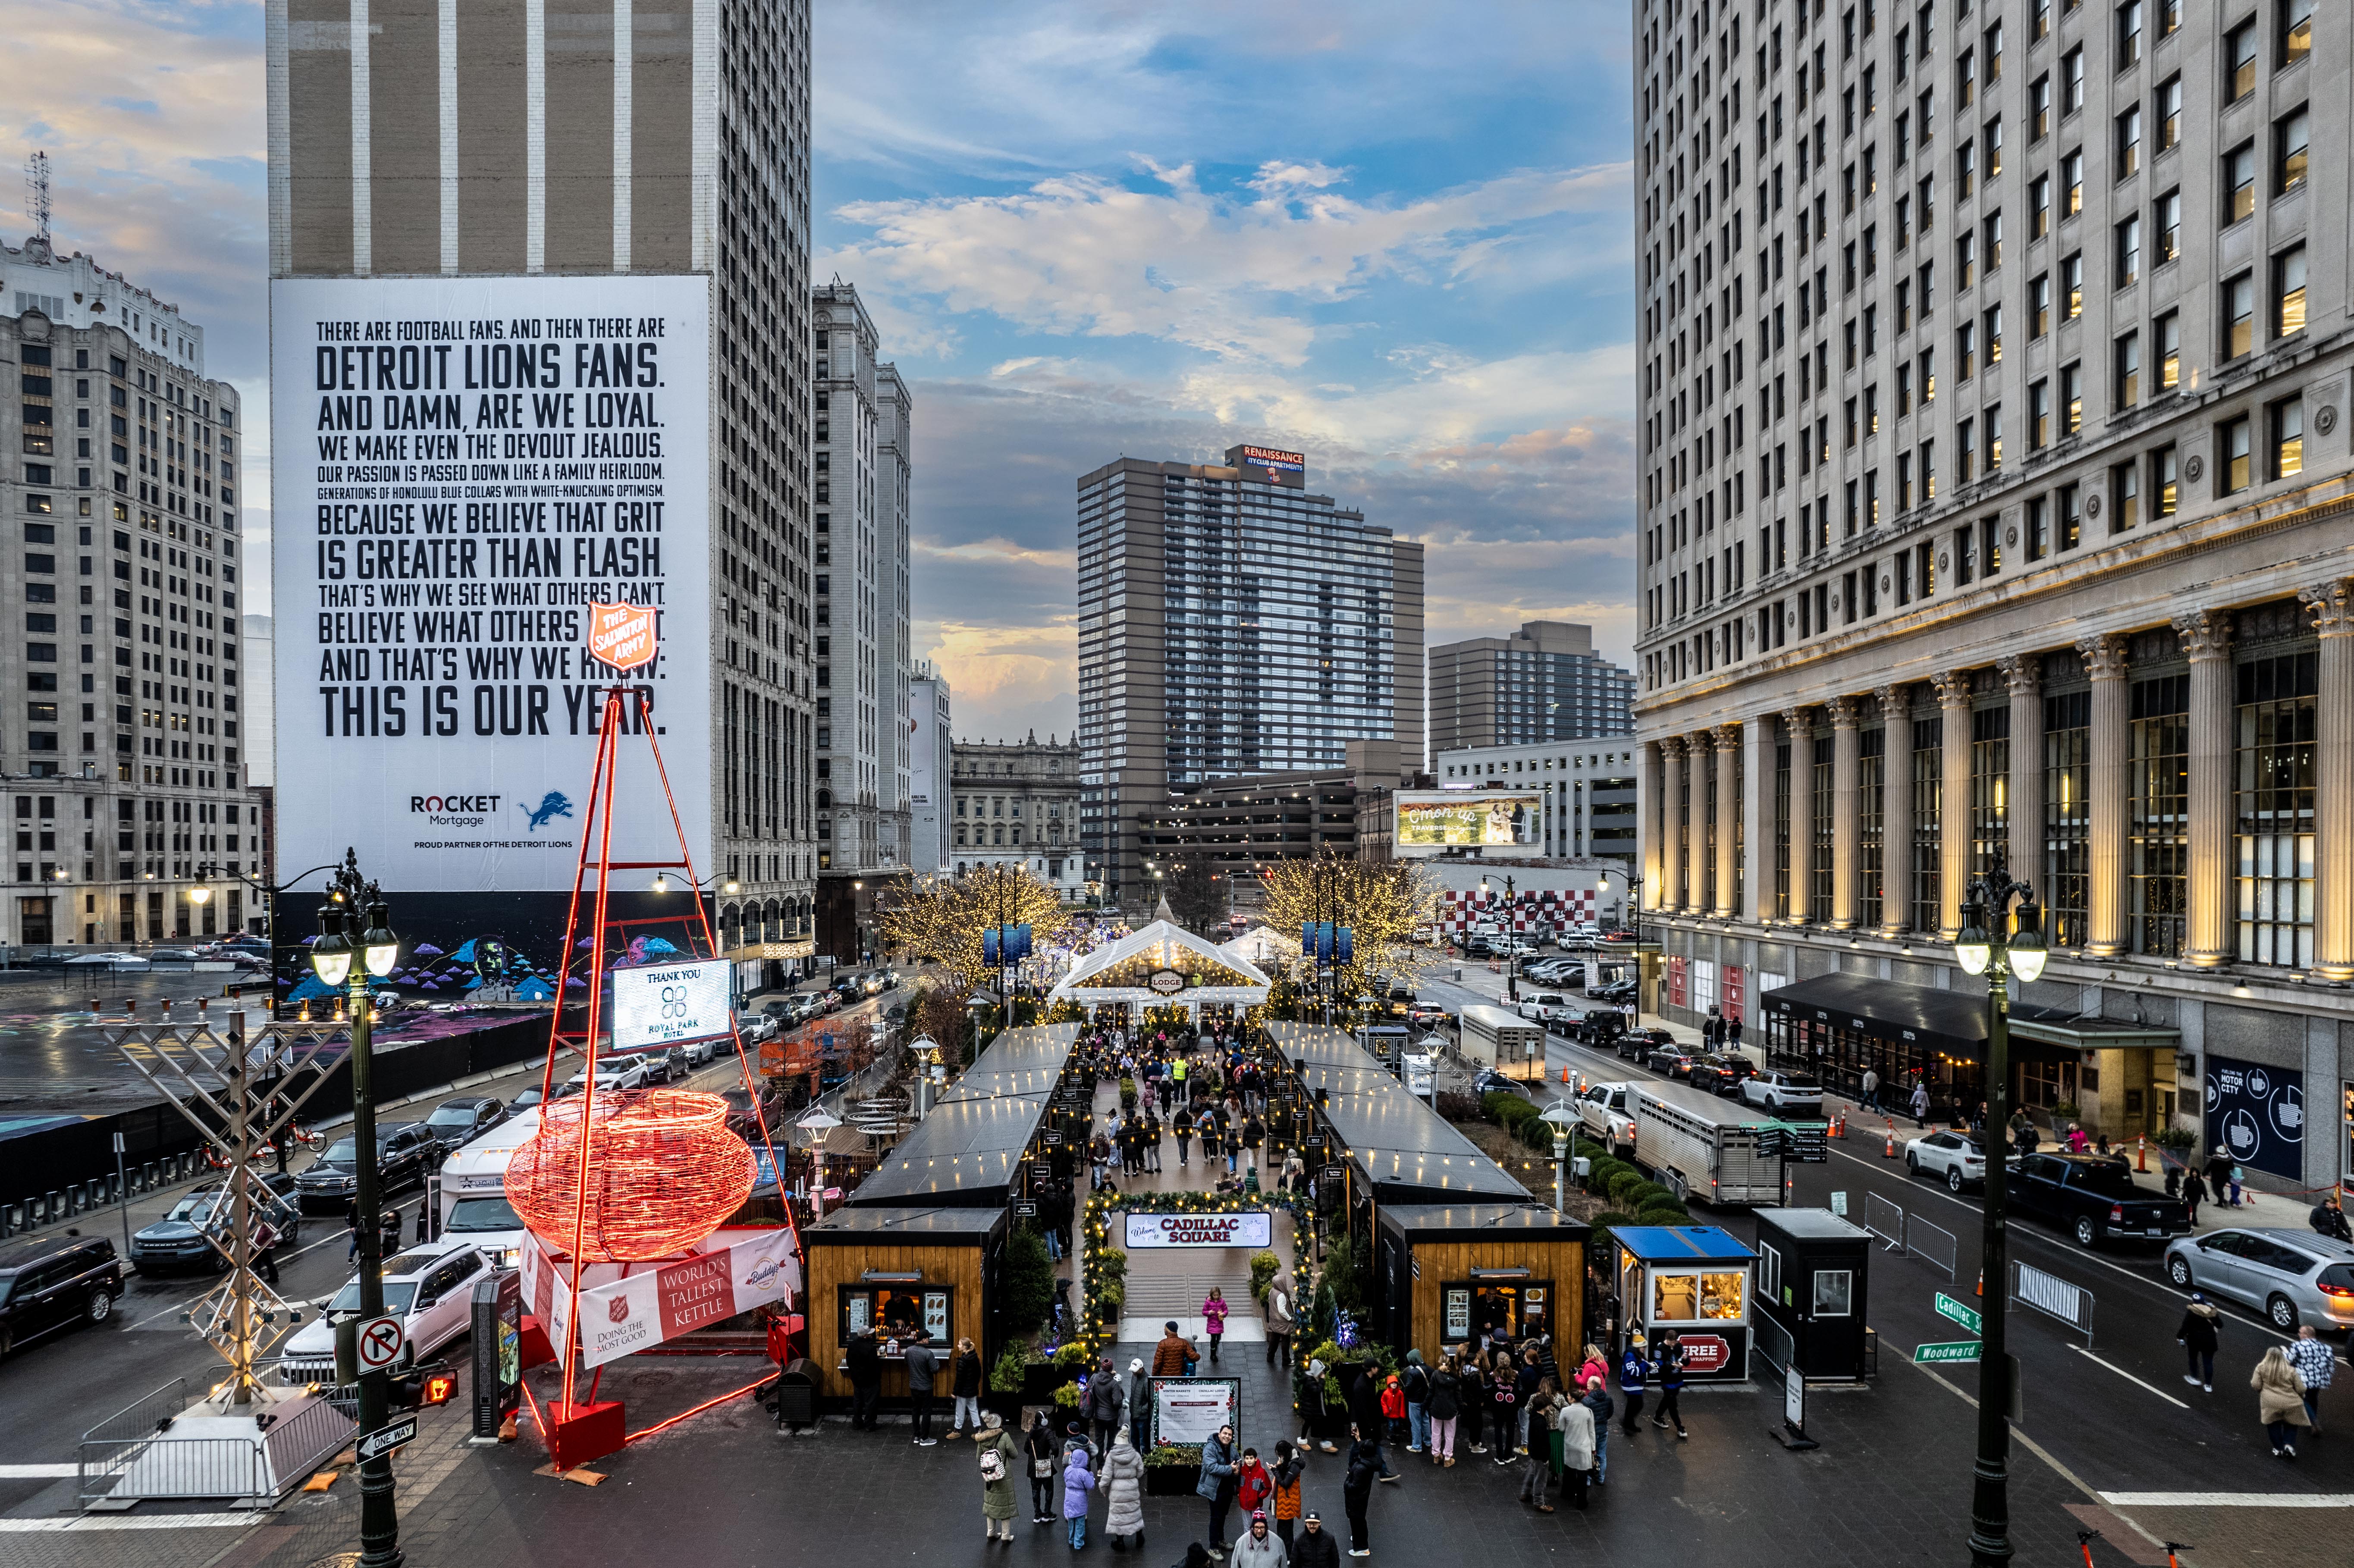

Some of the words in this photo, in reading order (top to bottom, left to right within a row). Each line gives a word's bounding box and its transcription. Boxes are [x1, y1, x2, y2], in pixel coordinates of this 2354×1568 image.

[316, 322, 360, 341] THERE
[364, 321, 391, 341] ARE
[397, 321, 465, 341] FOOTBALL
[470, 320, 506, 340] FANS.
[510, 319, 540, 339] AND
[546, 318, 582, 339] THEN
[588, 318, 632, 338] THERE
[637, 317, 665, 338] ARE
[317, 345, 452, 391] DETROIT
[465, 343, 560, 389] LIONS
[575, 342, 665, 388] FANS.
[317, 395, 372, 431] AND
[384, 395, 468, 433] DAMN,
[476, 393, 523, 429] ARE
[532, 393, 574, 428] WE
[585, 392, 665, 428] LOYAL.
[317, 436, 348, 461] WE
[355, 435, 407, 461] MAKE
[415, 435, 458, 460] EVEN
[465, 434, 496, 459] THE
[504, 433, 575, 459] DEVOUT
[581, 432, 665, 458] JEALOUS.
[1245, 446, 1303, 464] RENAISSANCE
[317, 466, 342, 483] OUR
[347, 465, 400, 482] PASSION
[405, 465, 417, 482] IS
[421, 464, 467, 482] PASSED
[472, 464, 508, 481] DOWN
[514, 464, 538, 480] LIKE
[542, 464, 550, 480] A
[555, 463, 596, 480] FAMILY
[599, 463, 665, 480] HEIRLOOM.
[1270, 461, 1303, 471] APARTMENTS
[318, 487, 377, 500] GENERATIONS
[380, 487, 389, 499] OF
[392, 486, 438, 499] HONOLULU
[441, 486, 462, 499] BLUE
[465, 486, 501, 498] COLLARS
[504, 485, 527, 498] WITH
[530, 485, 614, 497] WHITE-KNUCKLING
[617, 484, 665, 497] OPTIMISM.
[318, 504, 415, 535] BECAUSE
[422, 503, 457, 534] WE
[466, 502, 546, 533] BELIEVE
[553, 502, 607, 533] THAT
[615, 502, 665, 533] GRIT
[318, 539, 345, 580] IS
[357, 539, 477, 580] GREATER
[486, 538, 561, 578] THAN
[574, 537, 665, 577] FLASH.
[318, 584, 374, 607] THAT'S
[380, 584, 421, 607] WHY
[426, 583, 452, 606] WE
[459, 583, 486, 606] SEE
[490, 583, 541, 605] WHAT
[547, 582, 611, 605] OTHERS
[618, 582, 665, 605] CAN'T.
[319, 612, 405, 644] BELIEVE
[413, 611, 482, 643] WHAT
[490, 610, 578, 642] OTHERS
[603, 609, 628, 629] THE
[595, 614, 647, 652] SALVATION
[614, 632, 646, 662] ARMY
[320, 649, 370, 682] AND
[378, 647, 458, 681] THAT'S
[466, 647, 523, 681] WHY
[532, 647, 570, 680] WE
[320, 686, 406, 737] THIS
[423, 686, 458, 736] IS
[474, 685, 549, 736] OUR
[411, 795, 501, 813] ROCKET
[430, 815, 484, 827] Mortgage
[1409, 807, 1454, 824] C'mon
[1458, 809, 1478, 824] up
[1525, 902, 1583, 924] Detroit
[647, 971, 680, 983] THANK
[682, 969, 700, 980] YOU
[648, 1024, 674, 1034] ROYAL
[678, 1019, 699, 1029] PARK
[664, 1030, 684, 1038] HOTEL
[2221, 1074, 2243, 1087] MOTOR
[2221, 1084, 2238, 1094] CITY
[1131, 1226, 1156, 1237] Welcome
[1161, 1218, 1240, 1231] CADILLAC
[1168, 1231, 1231, 1243] SQUARE
[755, 1245, 768, 1254] presented
[539, 1260, 553, 1289] WORLD'S
[664, 1257, 726, 1289] WORLD'S
[751, 1263, 779, 1285] Buddy's
[538, 1278, 551, 1308] TALLEST
[669, 1278, 724, 1308] TALLEST
[537, 1301, 549, 1327] KETTLE
[610, 1300, 626, 1320] SALVATION
[616, 1308, 626, 1321] ARMY
[675, 1298, 723, 1327] KETTLE
[1939, 1295, 1970, 1323] Cadillac
[596, 1339, 619, 1354] MOST
[621, 1329, 647, 1344] GOOD
[598, 1326, 626, 1343] DOING
[628, 1320, 643, 1332] THE
[1923, 1345, 1975, 1359] Woodward
[1626, 1361, 1635, 1370] 60
[374, 1435, 392, 1449] ONE
[394, 1425, 411, 1440] WAY
